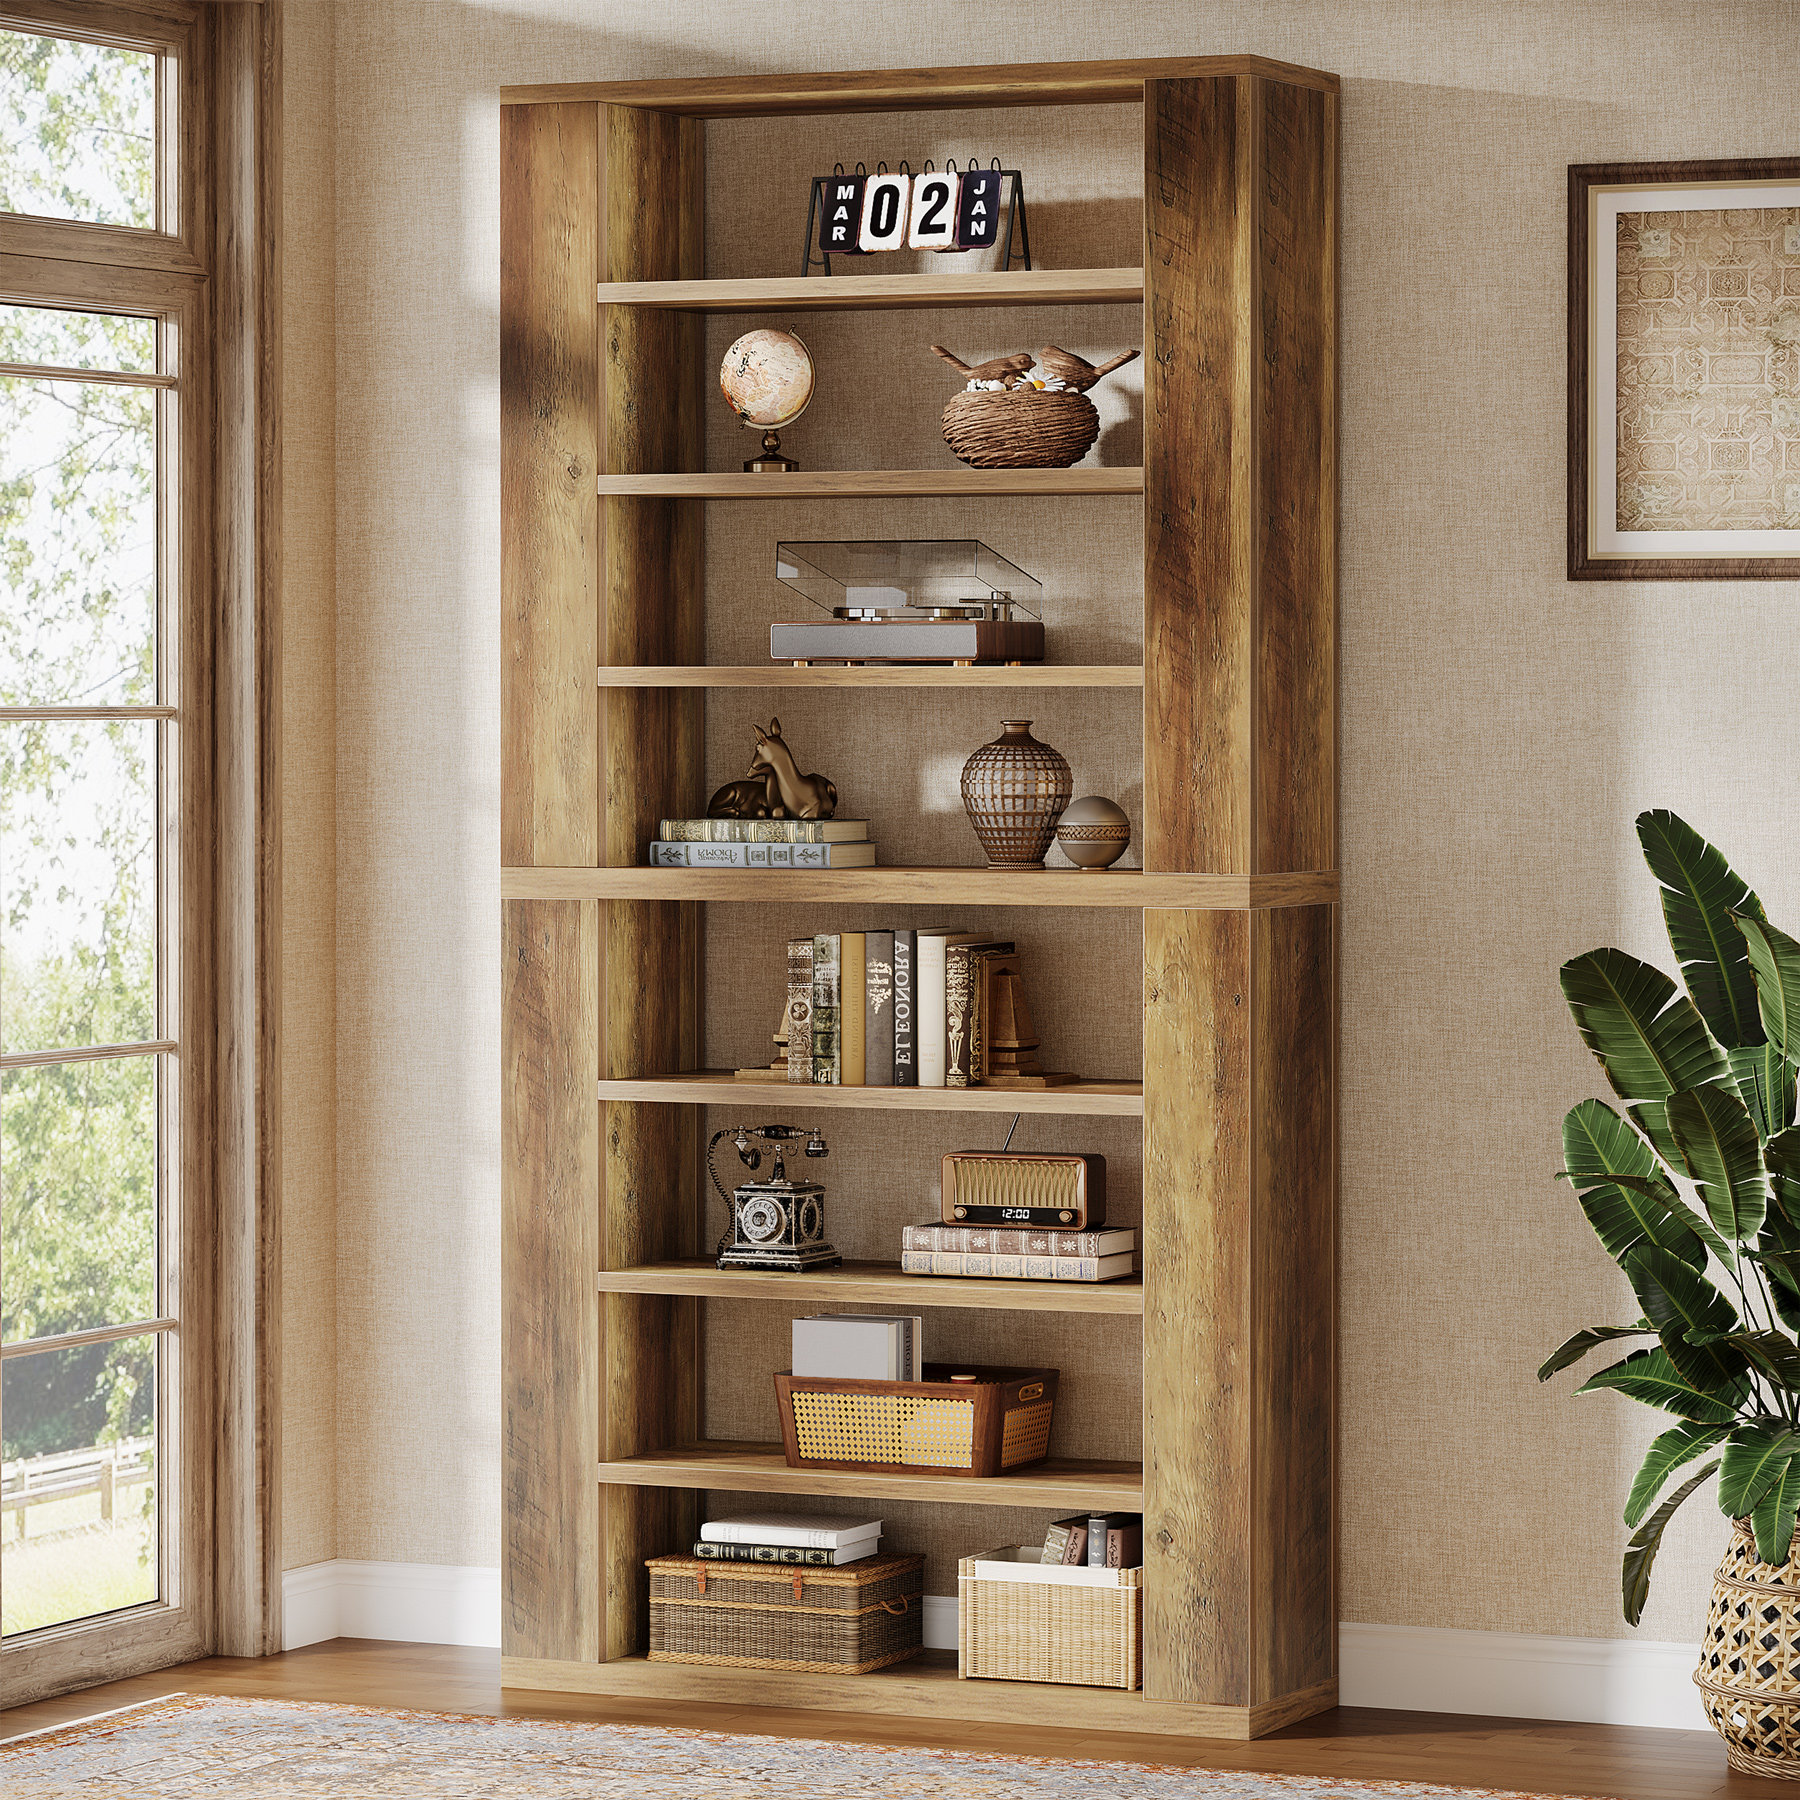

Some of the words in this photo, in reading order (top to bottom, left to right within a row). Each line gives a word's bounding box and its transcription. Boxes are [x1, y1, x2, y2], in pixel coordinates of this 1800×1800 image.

[832, 185, 854, 241] MAR
[970, 180, 987, 236] JAN
[1001, 1208, 1030, 1219] 12:00
